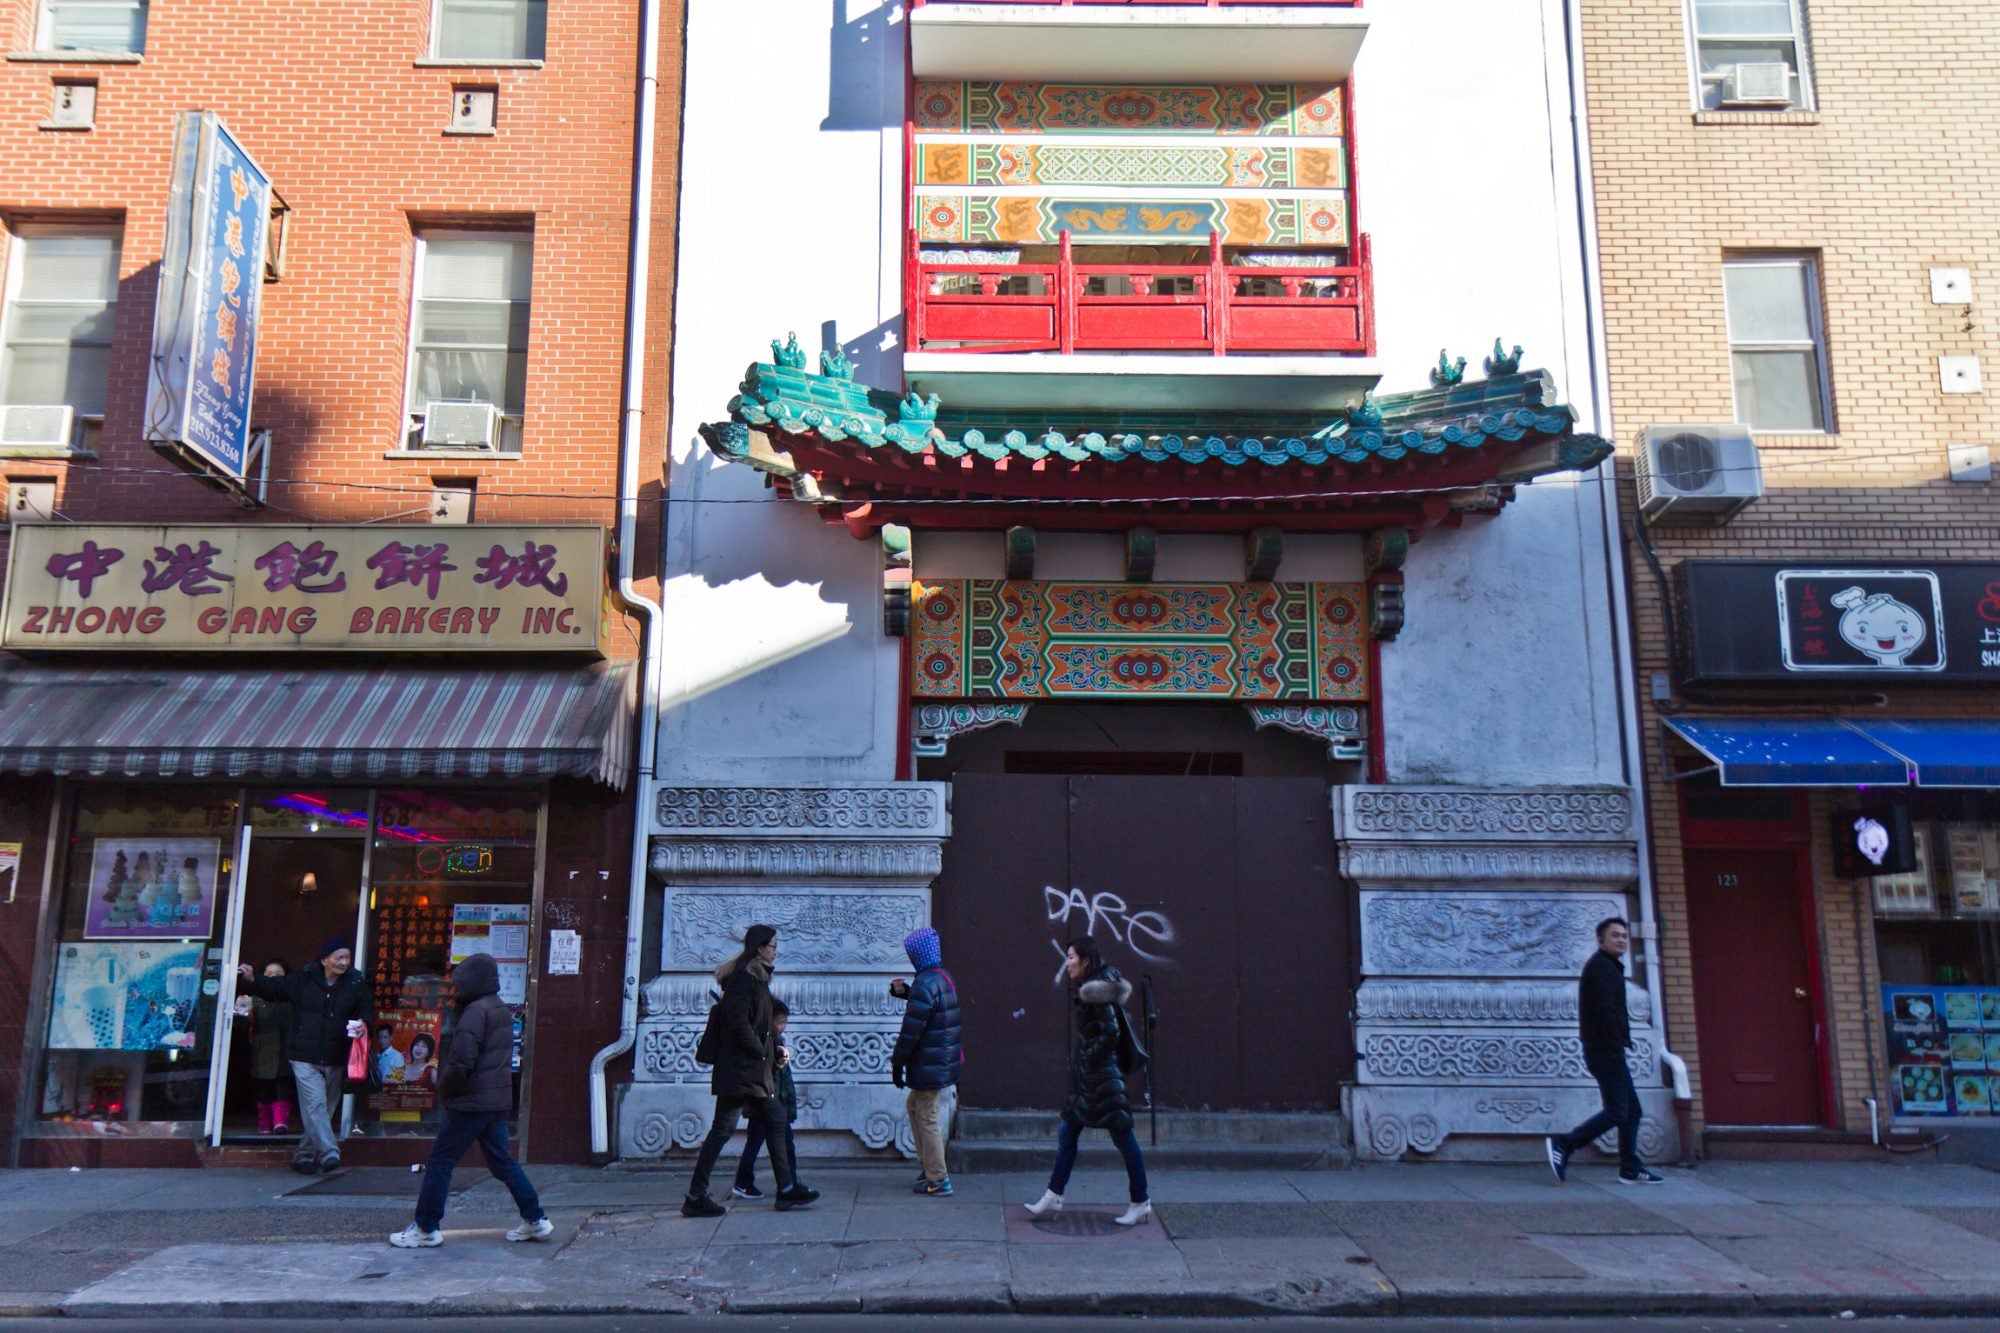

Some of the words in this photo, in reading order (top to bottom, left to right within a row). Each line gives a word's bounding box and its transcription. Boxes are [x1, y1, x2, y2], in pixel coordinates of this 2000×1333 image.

[20, 606, 167, 635] ZHONG
[197, 606, 317, 635] GANG
[349, 606, 500, 635] BAKERY
[521, 607, 582, 635] INC.
[1717, 874, 1738, 886] 123
